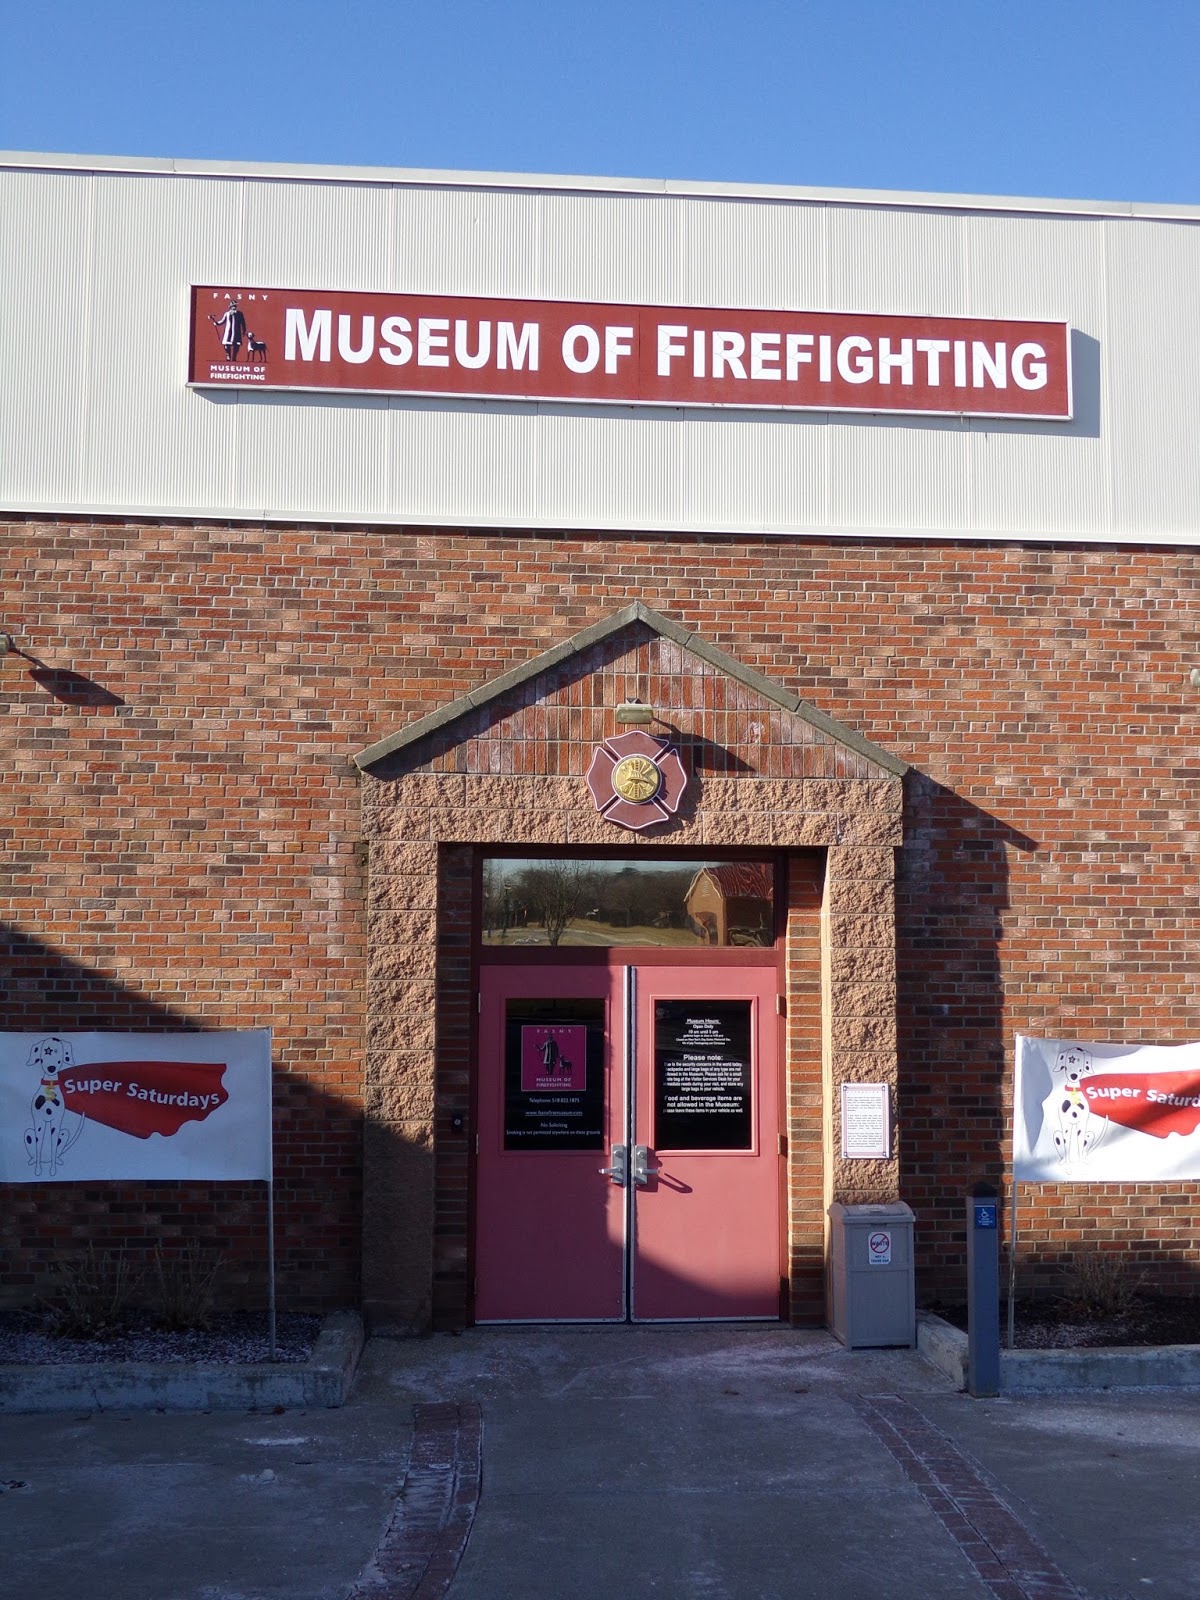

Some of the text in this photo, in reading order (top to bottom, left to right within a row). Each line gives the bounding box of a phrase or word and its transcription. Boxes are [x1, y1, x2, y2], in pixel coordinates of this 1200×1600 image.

[213, 292, 268, 300] FASNY
[284, 308, 1048, 391] MUSEUM OF FIREFIGHTING
[64, 1078, 220, 1110] Super Saturdays
[1086, 1086, 1141, 1100] Super
